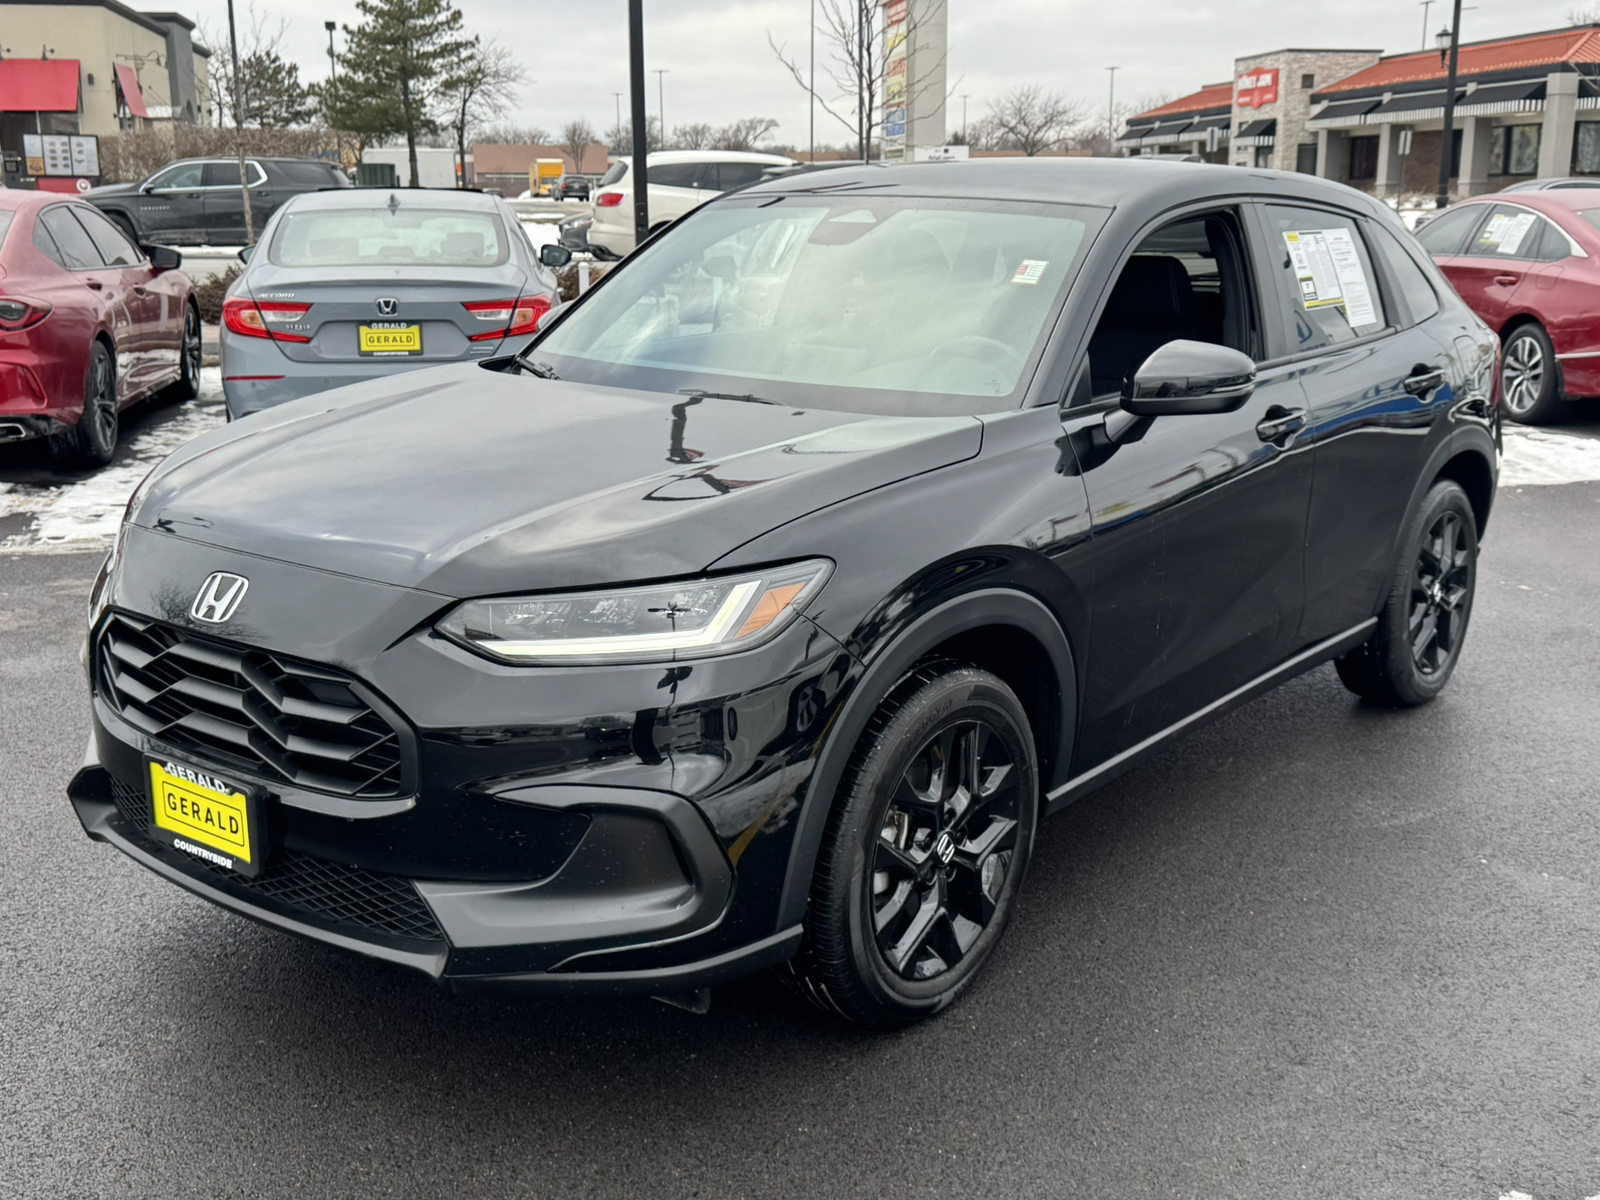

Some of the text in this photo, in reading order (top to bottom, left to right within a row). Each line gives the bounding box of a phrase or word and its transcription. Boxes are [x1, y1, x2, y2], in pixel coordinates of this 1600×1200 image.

[368, 335, 412, 344] GERALD
[166, 761, 225, 794] GERALD
[167, 792, 239, 835] GERALD
[173, 838, 233, 869] COUNTRYSIDE
